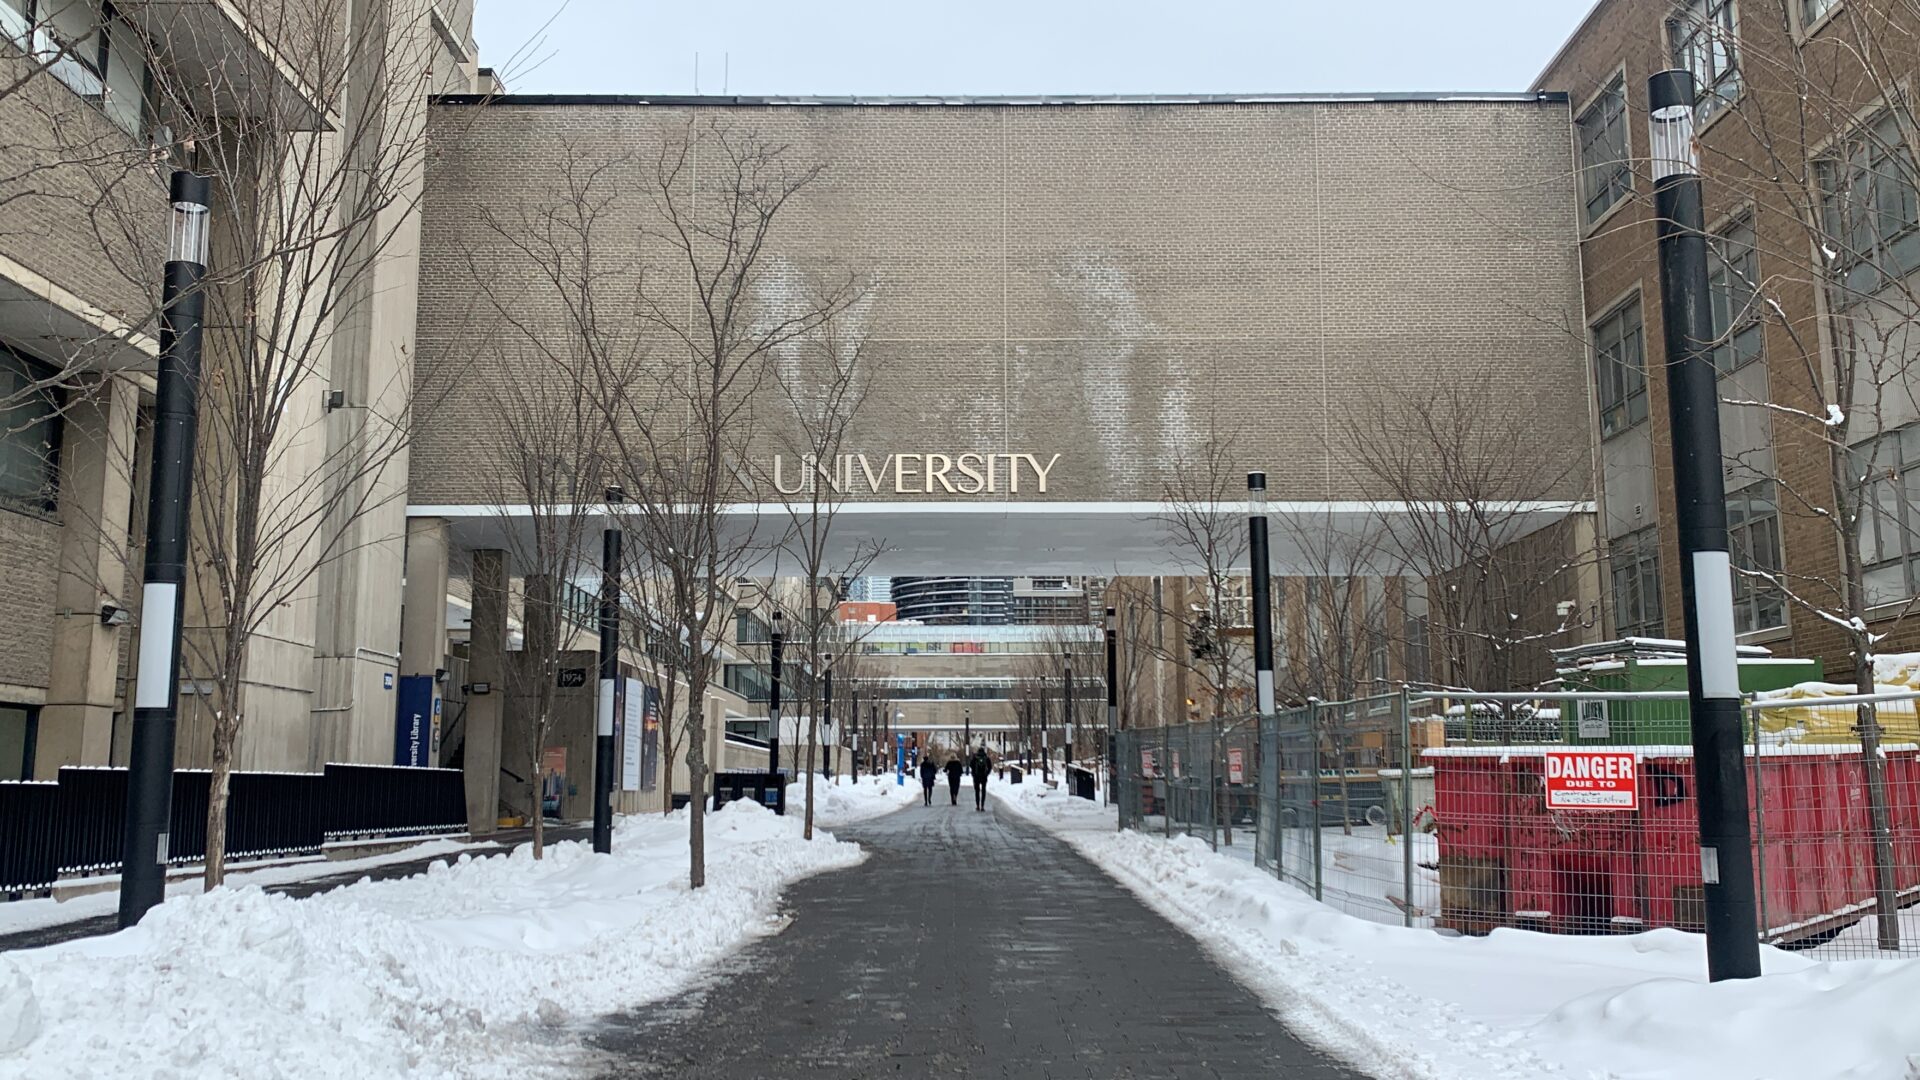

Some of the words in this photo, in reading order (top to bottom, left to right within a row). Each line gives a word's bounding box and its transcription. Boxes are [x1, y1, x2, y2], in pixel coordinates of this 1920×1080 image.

[774, 453, 1061, 494] UNIVERSITY
[409, 713, 422, 740] Library
[409, 741, 421, 767] versity
[1547, 756, 1633, 779] DANGER
[1566, 780, 1593, 788] DUE
[1598, 780, 1617, 788] TO
